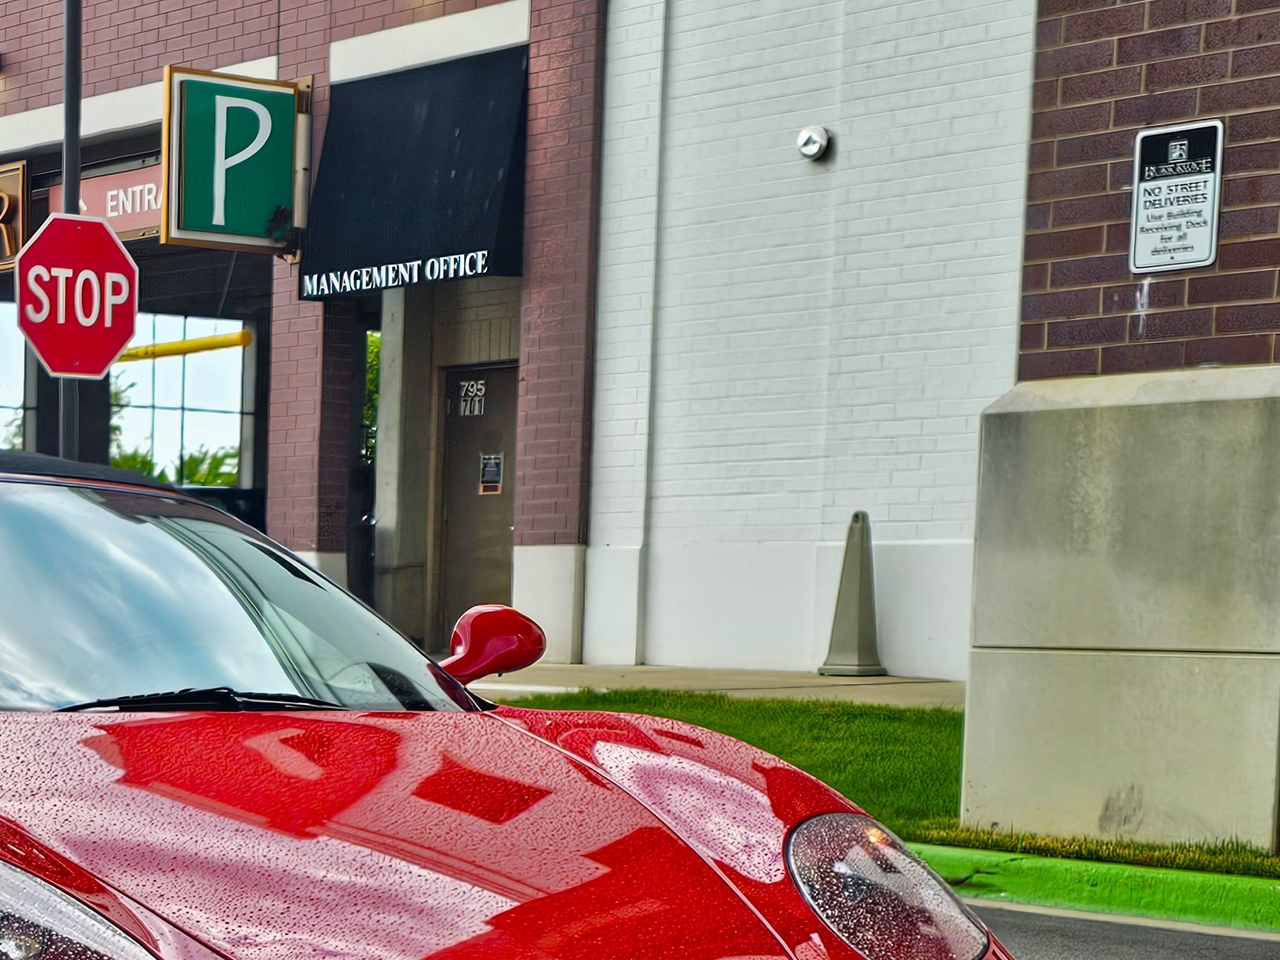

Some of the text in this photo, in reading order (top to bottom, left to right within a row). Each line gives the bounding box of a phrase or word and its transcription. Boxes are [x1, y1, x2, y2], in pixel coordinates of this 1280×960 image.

[212, 95, 272, 226] P
[106, 182, 163, 218] ENTR
[1143, 180, 1209, 198] NO STREET
[1143, 192, 1208, 210] DELIVERIES
[303, 250, 488, 297] MANAGEMENT OFFICE
[25, 265, 130, 328] STOP
[460, 380, 486, 397] 795
